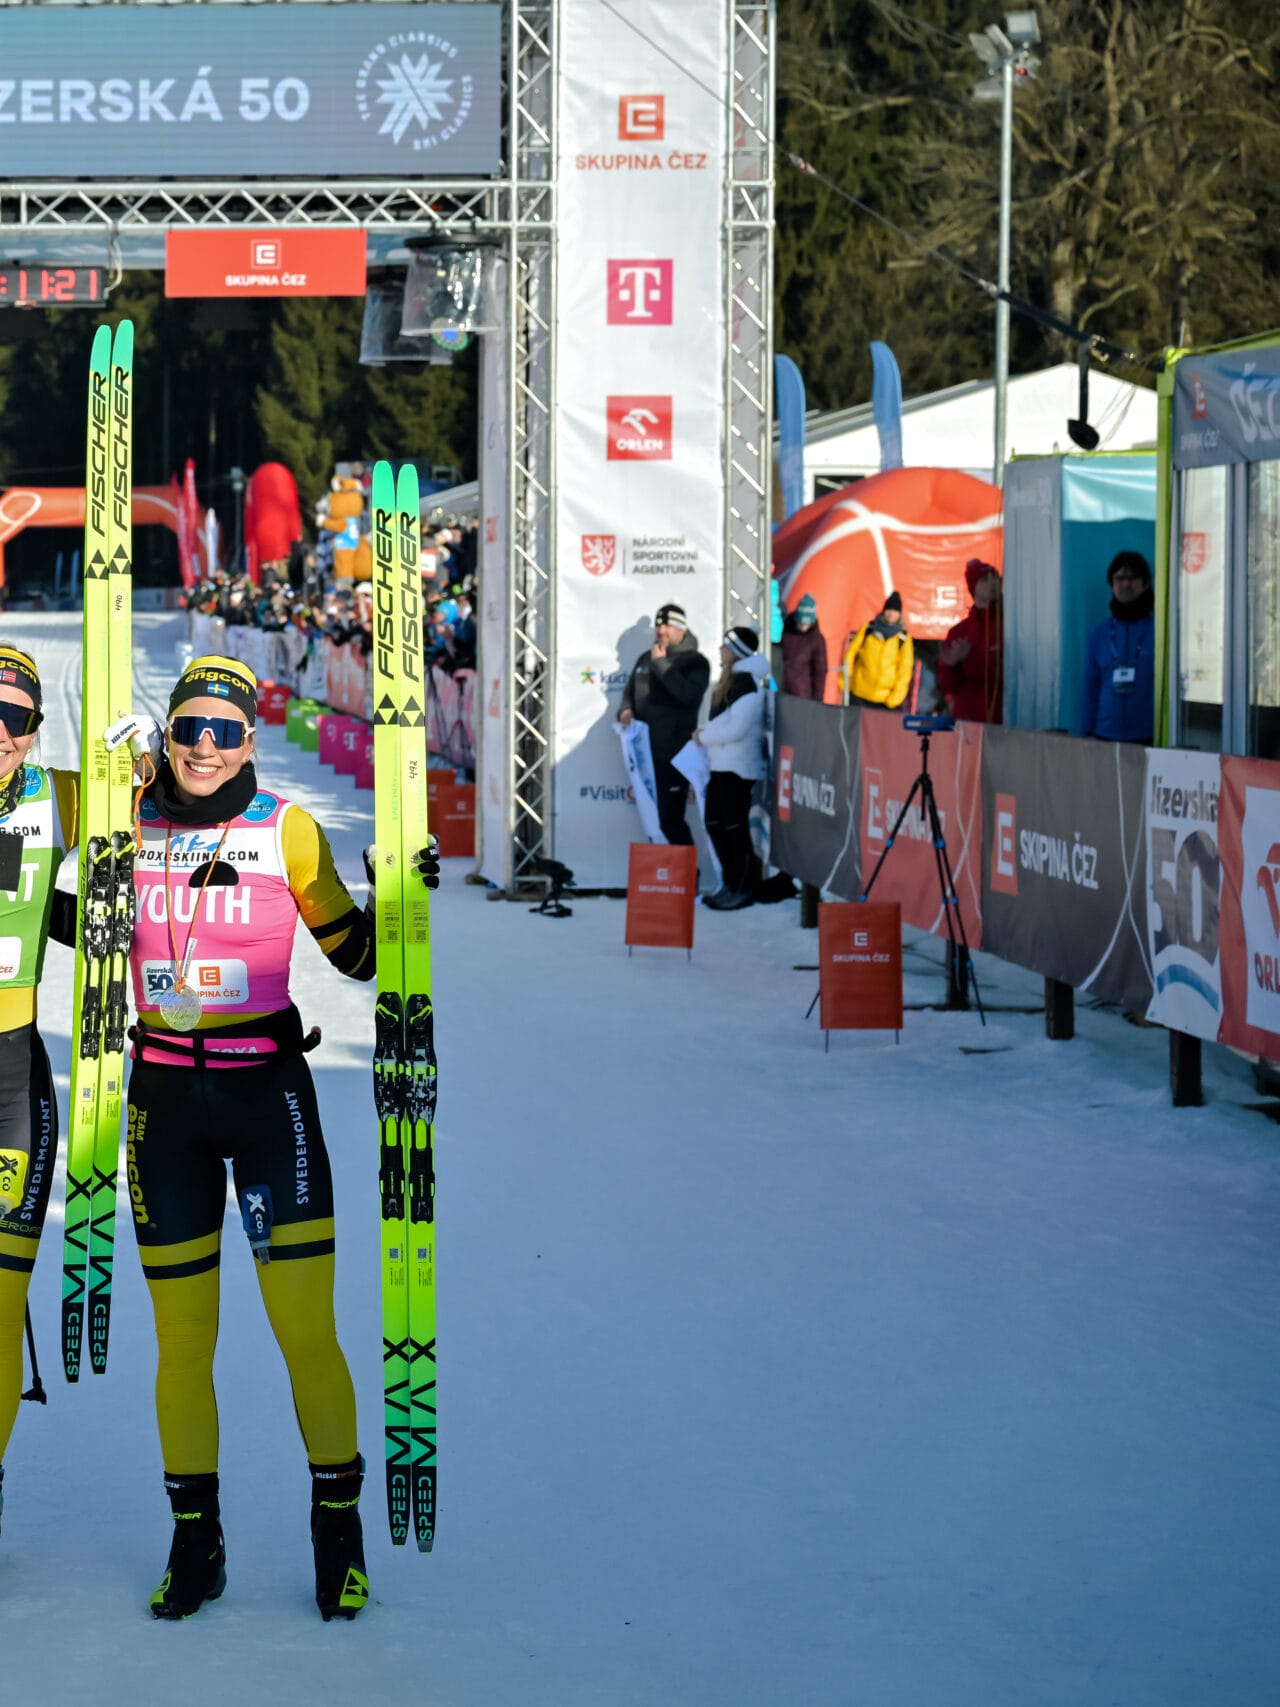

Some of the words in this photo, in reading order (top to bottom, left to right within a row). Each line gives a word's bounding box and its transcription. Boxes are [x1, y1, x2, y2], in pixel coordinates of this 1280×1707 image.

[238, 77, 310, 122] 50
[574, 153, 663, 171] SKUPINA
[667, 150, 707, 170] ČEZ
[224, 275, 276, 287] SKUPINA
[279, 272, 306, 286] ČEZ
[92, 371, 108, 538] FISCHER
[112, 365, 129, 532] FISCHER
[616, 439, 664, 451] ORLEN
[632, 565, 696, 575] AGENTURA
[377, 507, 395, 680] FISCHER
[400, 511, 420, 683] FISCHER
[185, 670, 250, 695] engcon
[1072, 833, 1100, 891] ČEZ
[134, 883, 251, 924] YOUTH
[147, 974, 174, 991] 50
[223, 988, 241, 998] ČEZ
[136, 1109, 148, 1142] TEAM
[20, 1098, 52, 1221] SWEDEMOUNT
[284, 1091, 309, 1205] SWEDEMOUNT
[171, 1512, 202, 1520] CHER
